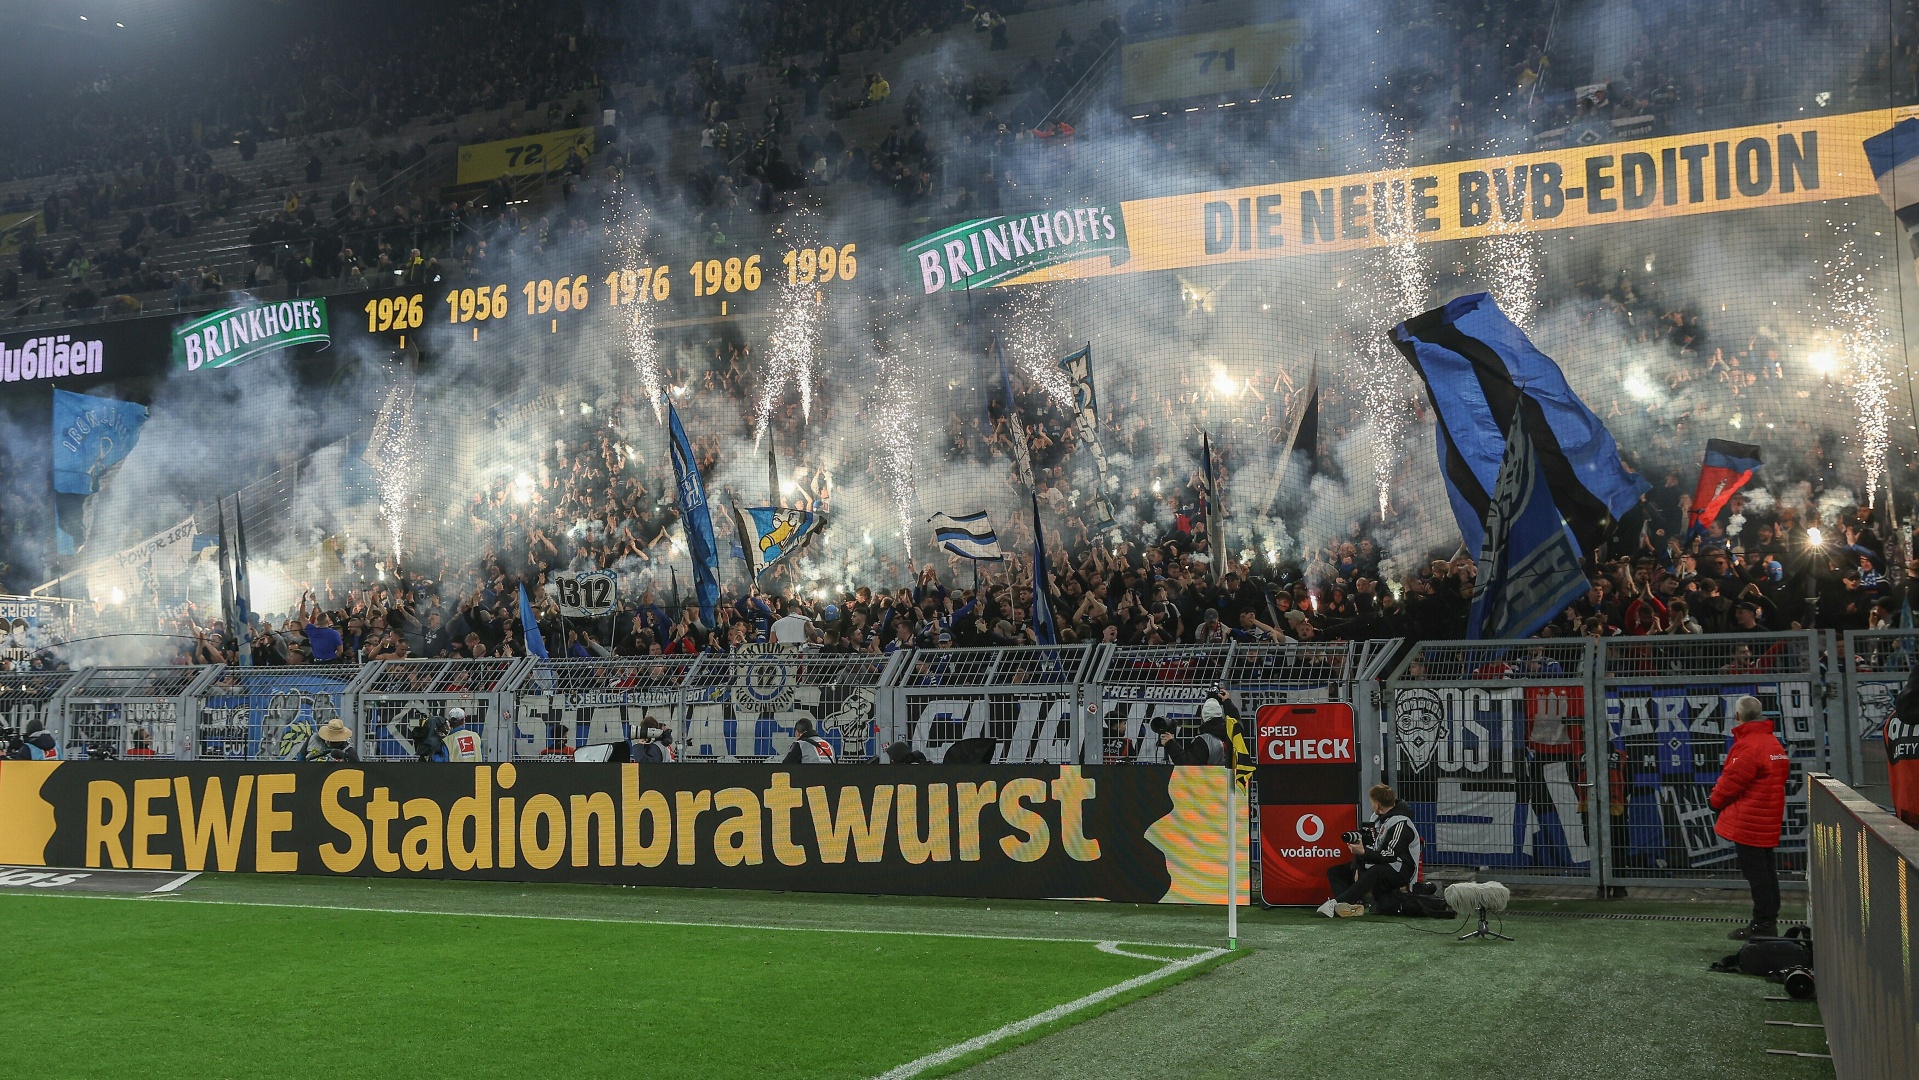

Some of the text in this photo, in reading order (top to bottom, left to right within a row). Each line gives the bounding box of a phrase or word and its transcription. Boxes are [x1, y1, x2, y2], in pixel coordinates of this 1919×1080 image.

[1194, 47, 1236, 75] 71
[505, 143, 543, 167] 72
[1204, 130, 1820, 256] DIE NEUE BVB-EDITION
[917, 206, 1116, 294] BRINKHOFF's
[364, 243, 858, 333] 1926 1956 1966 1976 1986 1996
[184, 301, 321, 372] BRINKHOFF's
[555, 577, 611, 609] 1312
[1102, 685, 1140, 698] FREE
[1260, 726, 1298, 737] SPEED
[1268, 738, 1350, 760] CHECK
[85, 762, 1102, 873] REWE Stadionbratwurst
[1281, 846, 1341, 858] vodafone
